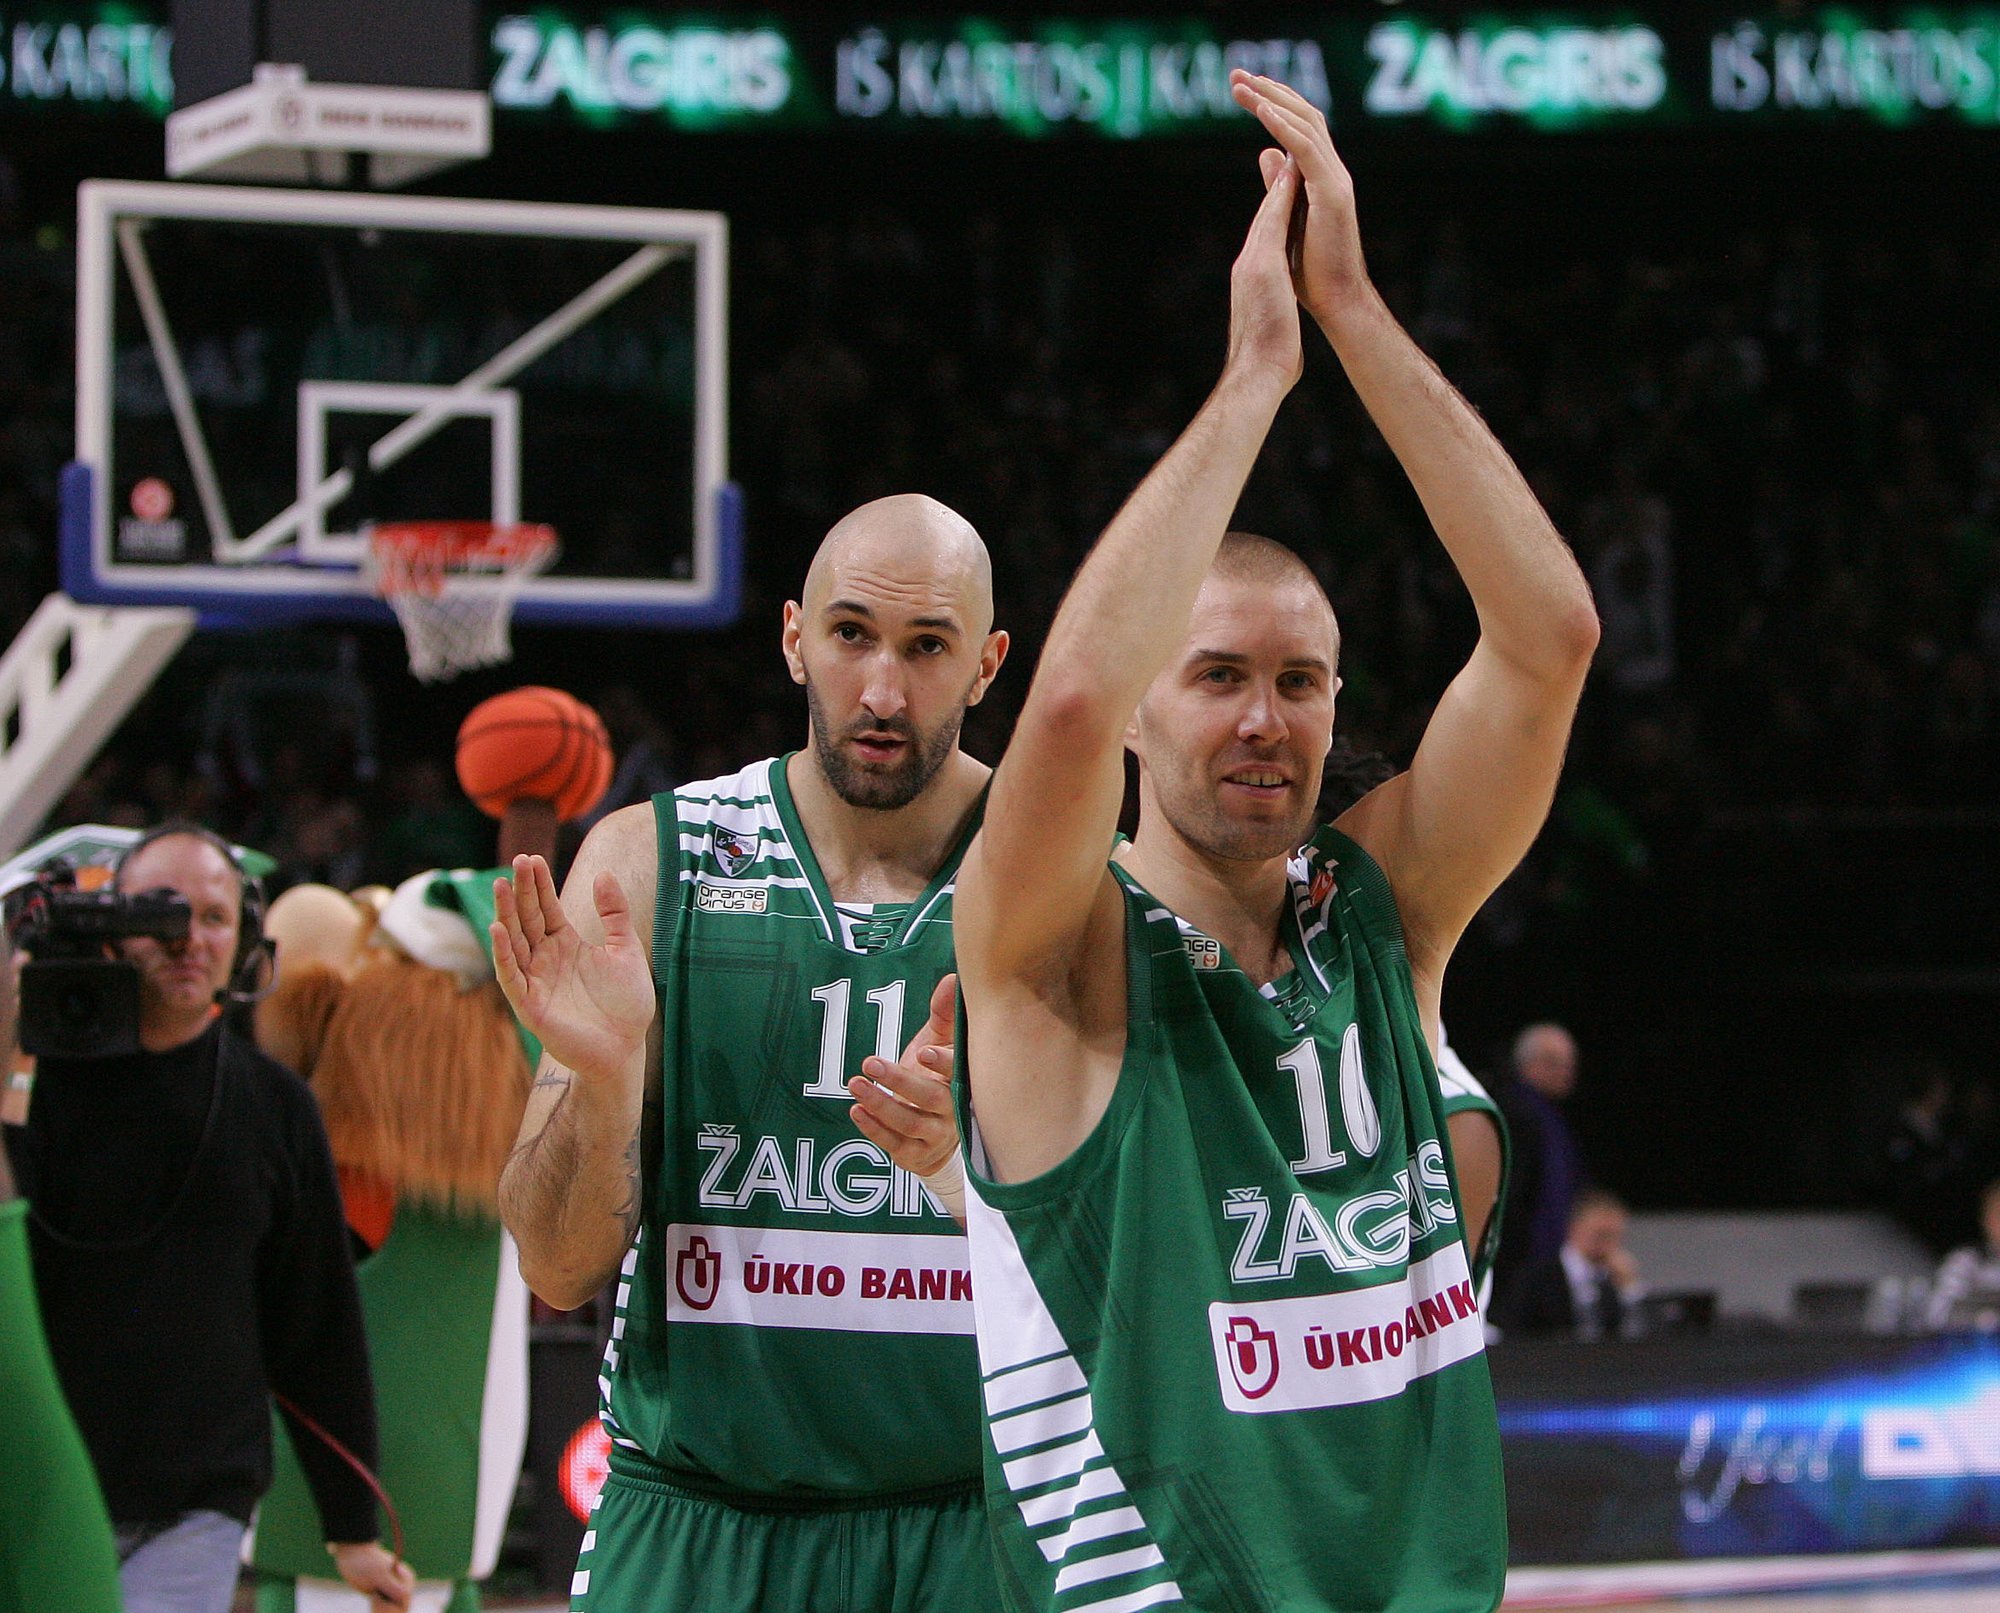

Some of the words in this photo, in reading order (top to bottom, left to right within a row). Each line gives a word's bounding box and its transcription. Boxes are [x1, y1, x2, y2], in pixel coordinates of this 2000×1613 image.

[803, 978, 906, 1100] 11
[1276, 1022, 1381, 1174] 10
[743, 1254, 845, 1298] ŪKIO
[1304, 1325, 1403, 1371] ŪKIO
[1405, 1279, 1477, 1344] ANK
